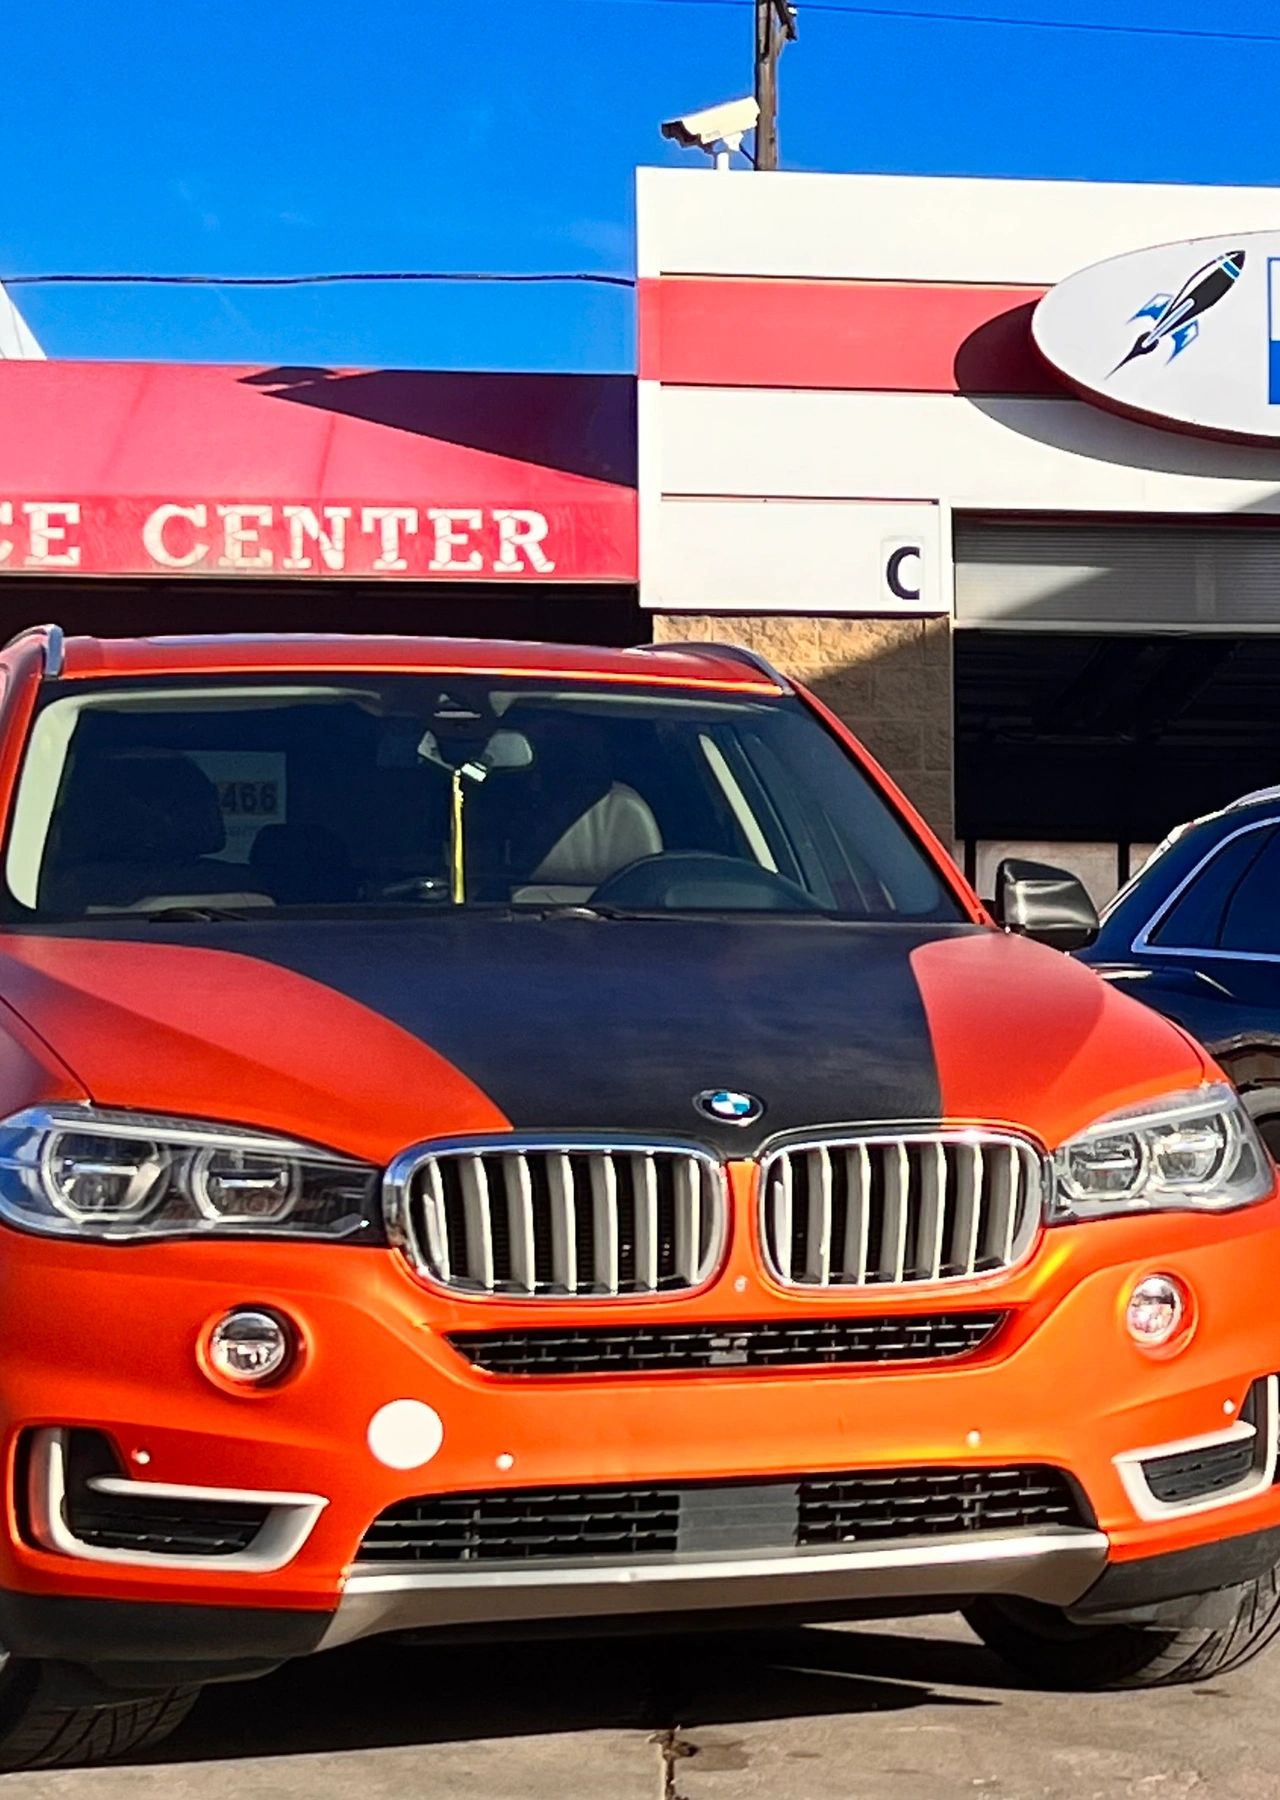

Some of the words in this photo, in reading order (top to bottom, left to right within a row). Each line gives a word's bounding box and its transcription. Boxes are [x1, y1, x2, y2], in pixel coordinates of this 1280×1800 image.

[0, 500, 80, 568] E
[142, 503, 556, 574] CENTER
[886, 545, 921, 601] C
